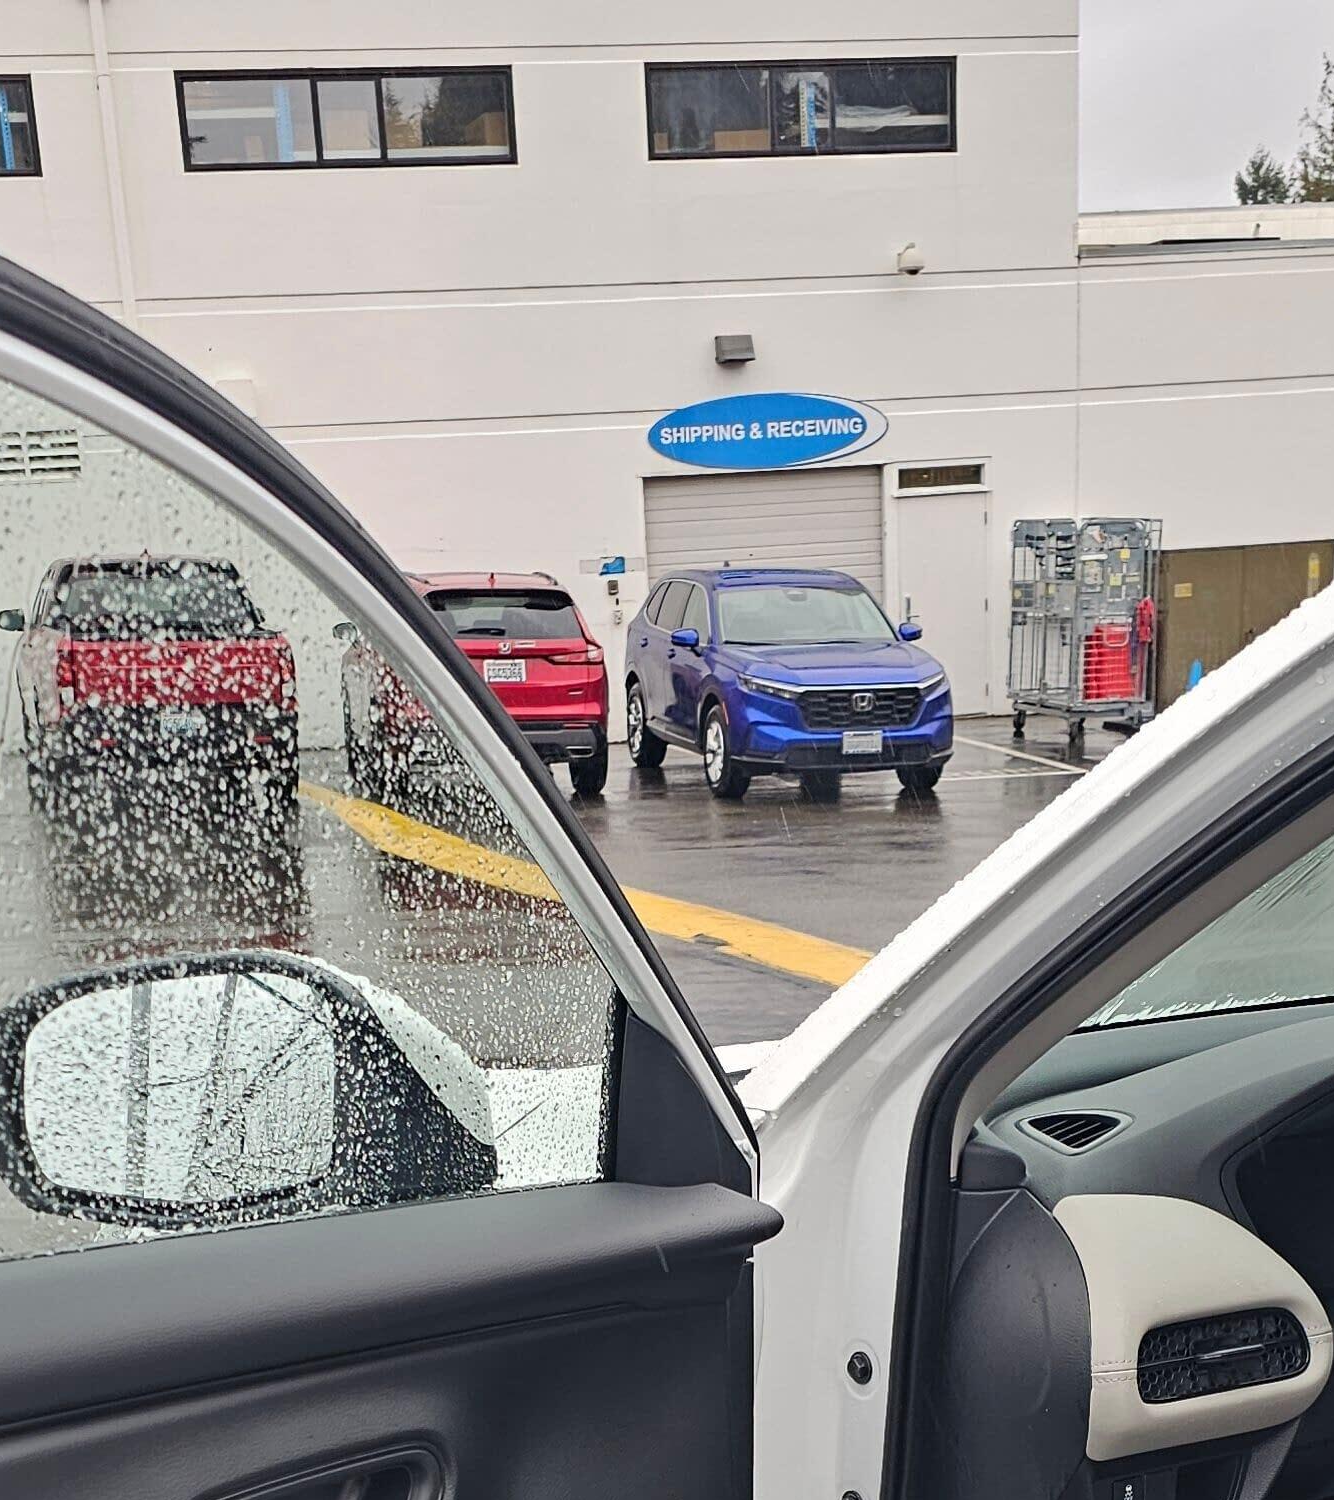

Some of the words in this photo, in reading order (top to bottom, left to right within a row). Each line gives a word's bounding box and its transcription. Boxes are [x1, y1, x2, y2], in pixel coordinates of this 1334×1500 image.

[660, 424, 746, 444] SHIPPING
[749, 422, 763, 439] &
[766, 417, 864, 439] RECEIVING
